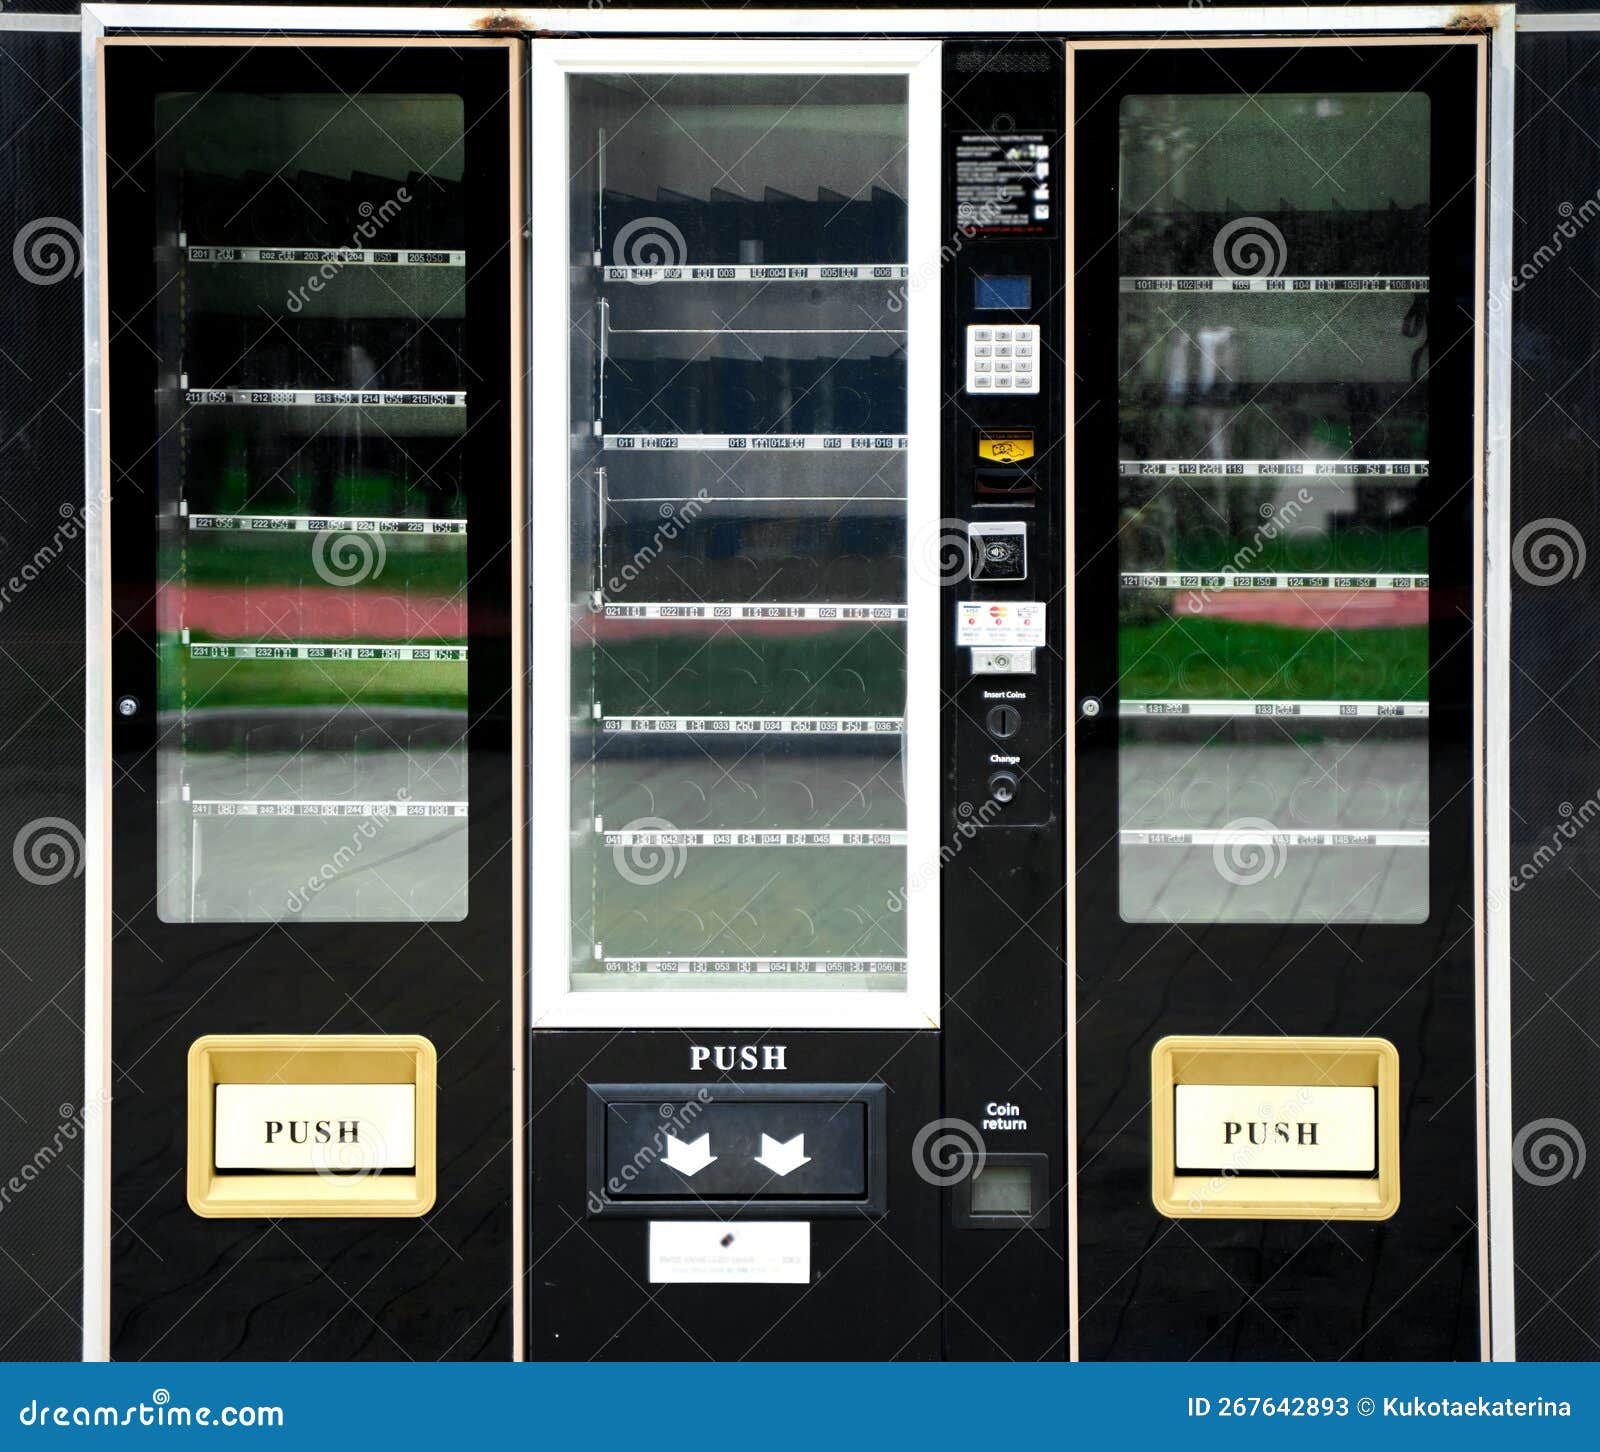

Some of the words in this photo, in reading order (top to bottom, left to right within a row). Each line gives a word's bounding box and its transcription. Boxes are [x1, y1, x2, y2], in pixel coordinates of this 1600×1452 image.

[192, 250, 208, 258] 201
[261, 251, 275, 259] 202
[303, 252, 319, 260] 203
[409, 253, 424, 262] 205
[611, 269, 626, 278] 001
[719, 269, 735, 277] 003
[769, 269, 785, 277] 004
[822, 269, 838, 277] 005
[875, 268, 891, 277] 006
[1136, 280, 1152, 289] 101
[1178, 281, 1194, 289] 102
[185, 392, 200, 401] 211
[253, 393, 268, 402] 212
[316, 394, 332, 402] 213
[363, 394, 378, 403] 214
[412, 395, 427, 403] 215
[618, 438, 634, 447] 011
[661, 438, 677, 447] 012
[729, 439, 746, 447] 013
[771, 439, 786, 447] 014
[824, 439, 840, 447] 015
[876, 439, 892, 447] 016
[1179, 465, 1195, 473] 112
[1227, 465, 1242, 473] 113
[1344, 465, 1359, 473] 115
[198, 518, 212, 526] 221
[253, 519, 268, 527] 222
[309, 520, 325, 529] 223
[358, 521, 374, 530] 224
[407, 522, 423, 531] 225
[1123, 576, 1138, 585] 121
[1182, 577, 1198, 585] 122
[1235, 577, 1250, 585] 123
[1289, 577, 1304, 585] 124
[1335, 577, 1351, 586] 125
[1395, 578, 1410, 586] 126
[606, 607, 621, 616] 021
[661, 607, 678, 616] 022
[714, 608, 731, 616] 023
[820, 608, 836, 617] 025
[193, 647, 208, 656] 231
[256, 648, 272, 656] 232
[309, 649, 324, 657] 233
[359, 649, 374, 657] 234
[414, 650, 429, 658] 235
[1148, 704, 1163, 713] 131
[605, 721, 621, 729] 031
[660, 721, 676, 729] 032
[713, 721, 729, 729] 033
[764, 721, 781, 730] 034
[820, 721, 836, 730] 035
[876, 722, 891, 730] 036
[990, 755, 1020, 764] Change
[661, 962, 678, 971] 052
[714, 963, 730, 971] 053
[690, 1046, 787, 1070] PUSH
[987, 1103, 1020, 1116] Coin
[983, 1118, 1026, 1130] return
[264, 1121, 360, 1144] PUSH
[1223, 1121, 1319, 1145] PUSH
